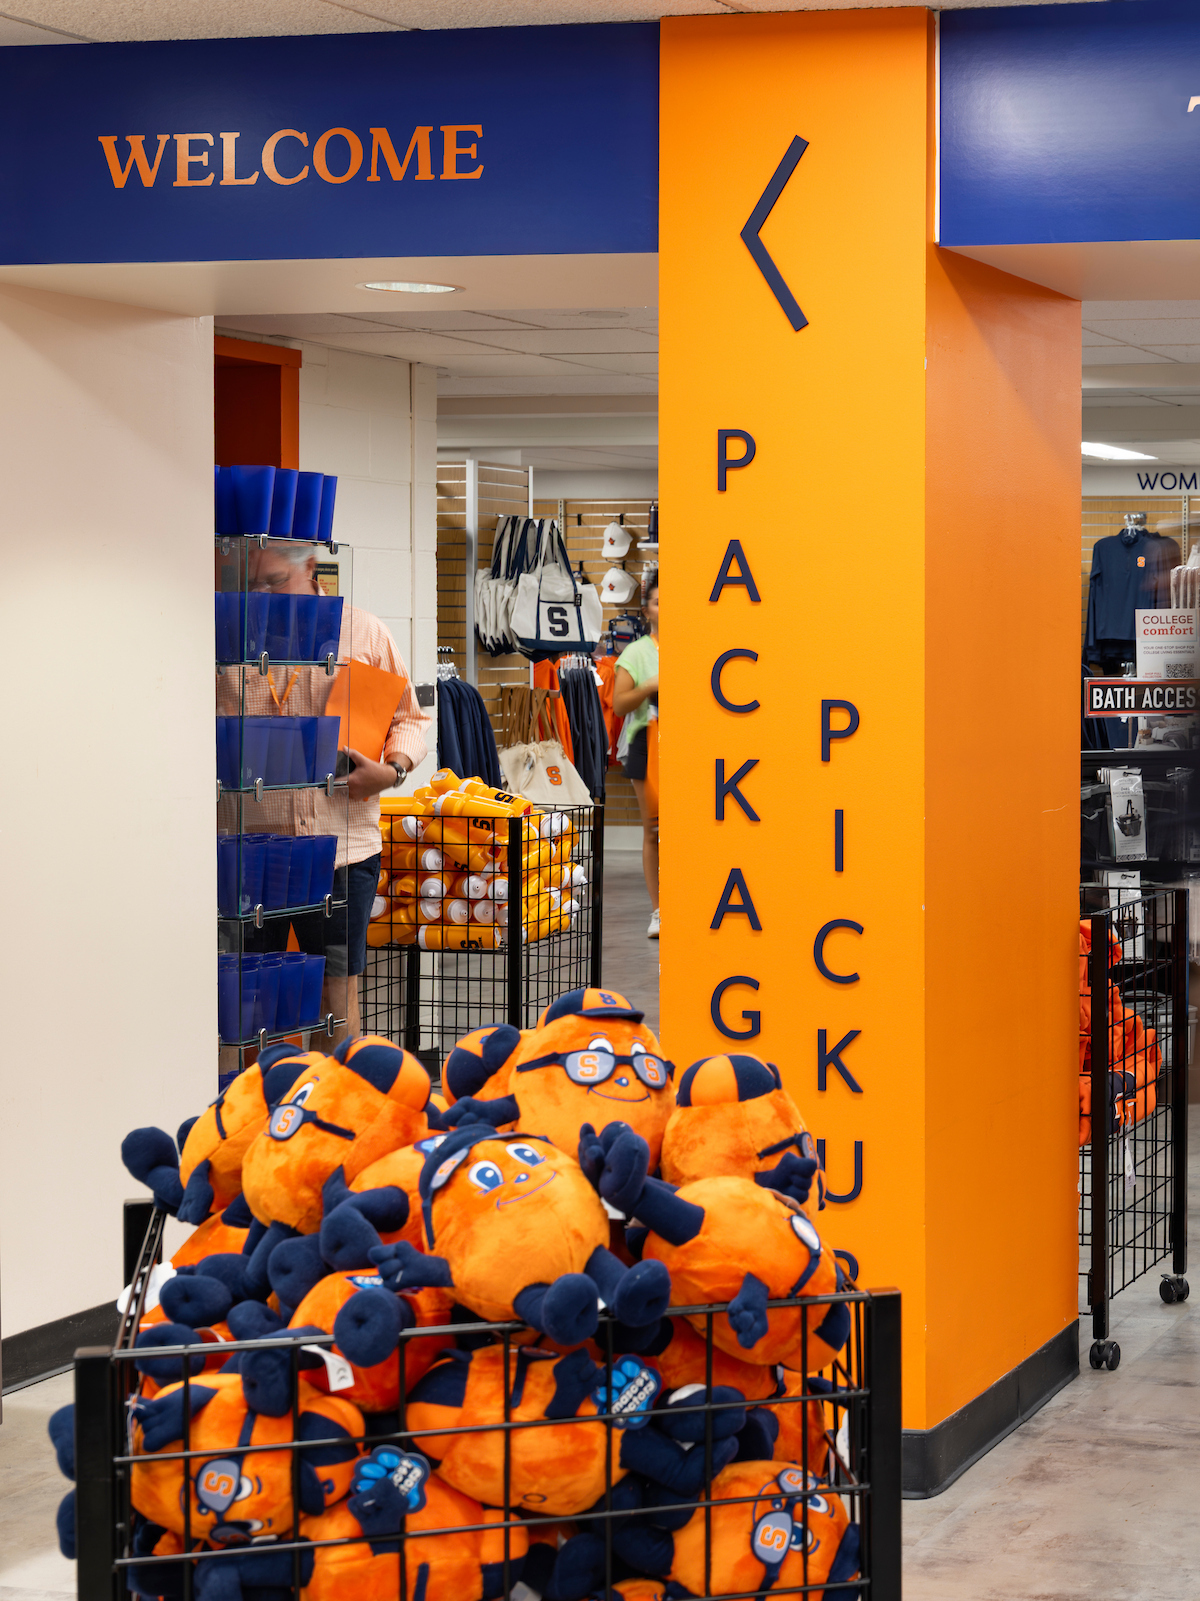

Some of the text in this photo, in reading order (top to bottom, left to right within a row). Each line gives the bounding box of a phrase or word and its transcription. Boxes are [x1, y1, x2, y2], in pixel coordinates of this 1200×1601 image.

[98, 124, 485, 189] WELCOME
[547, 606, 570, 637] S
[1142, 615, 1194, 624] COLLEGE
[1142, 625, 1194, 636] comfort
[1092, 687, 1197, 709] BATH ACCES
[709, 429, 763, 1041] PACKAG
[546, 766, 563, 786] S
[578, 1053, 600, 1078] S
[644, 1057, 660, 1082] S
[276, 1109, 297, 1134] S
[202, 1470, 236, 1498] S
[759, 1524, 788, 1552] S
